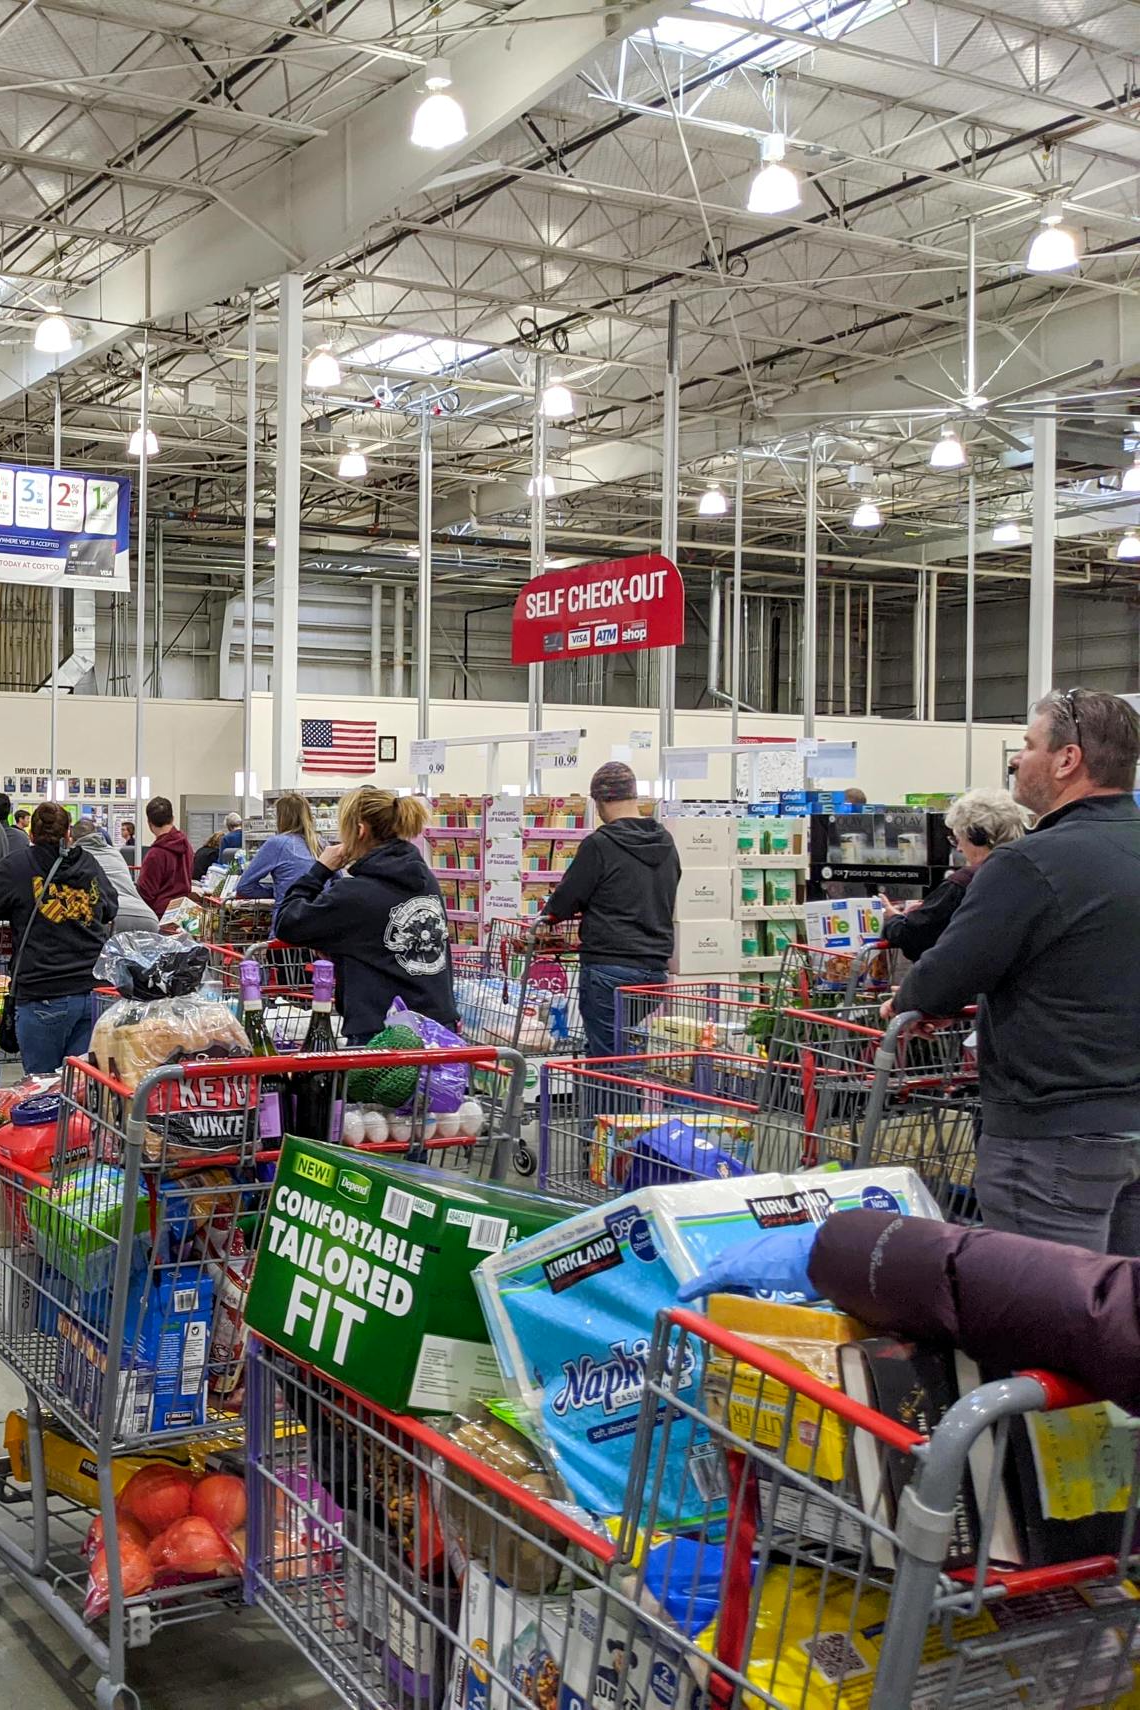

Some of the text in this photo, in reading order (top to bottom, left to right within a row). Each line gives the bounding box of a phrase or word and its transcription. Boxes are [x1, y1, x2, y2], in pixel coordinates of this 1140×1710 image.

[35, 540, 60, 549] ACCEPTED
[0, 560, 22, 568] TODAY
[32, 563, 60, 571] COSTCO
[99, 569, 113, 577] VISA
[525, 570, 668, 619] SELF CHECK-OUT
[571, 628, 647, 643] VISA ATM shop
[429, 763, 445, 774] 9.99
[554, 755, 577, 767] 10.99
[822, 915, 850, 935] life
[190, 1114, 244, 1137] WHITE
[298, 1157, 332, 1183] NEW!
[341, 1175, 370, 1196] Depend
[751, 1191, 830, 1217] KIRKLAND
[871, 1200, 889, 1208] Now
[275, 1184, 425, 1275] COMFORTABLE
[268, 1215, 413, 1317] TAILORED
[546, 1237, 616, 1280] KIRKLAND
[283, 1274, 367, 1366] FIT
[661, 1666, 670, 1680] 2
